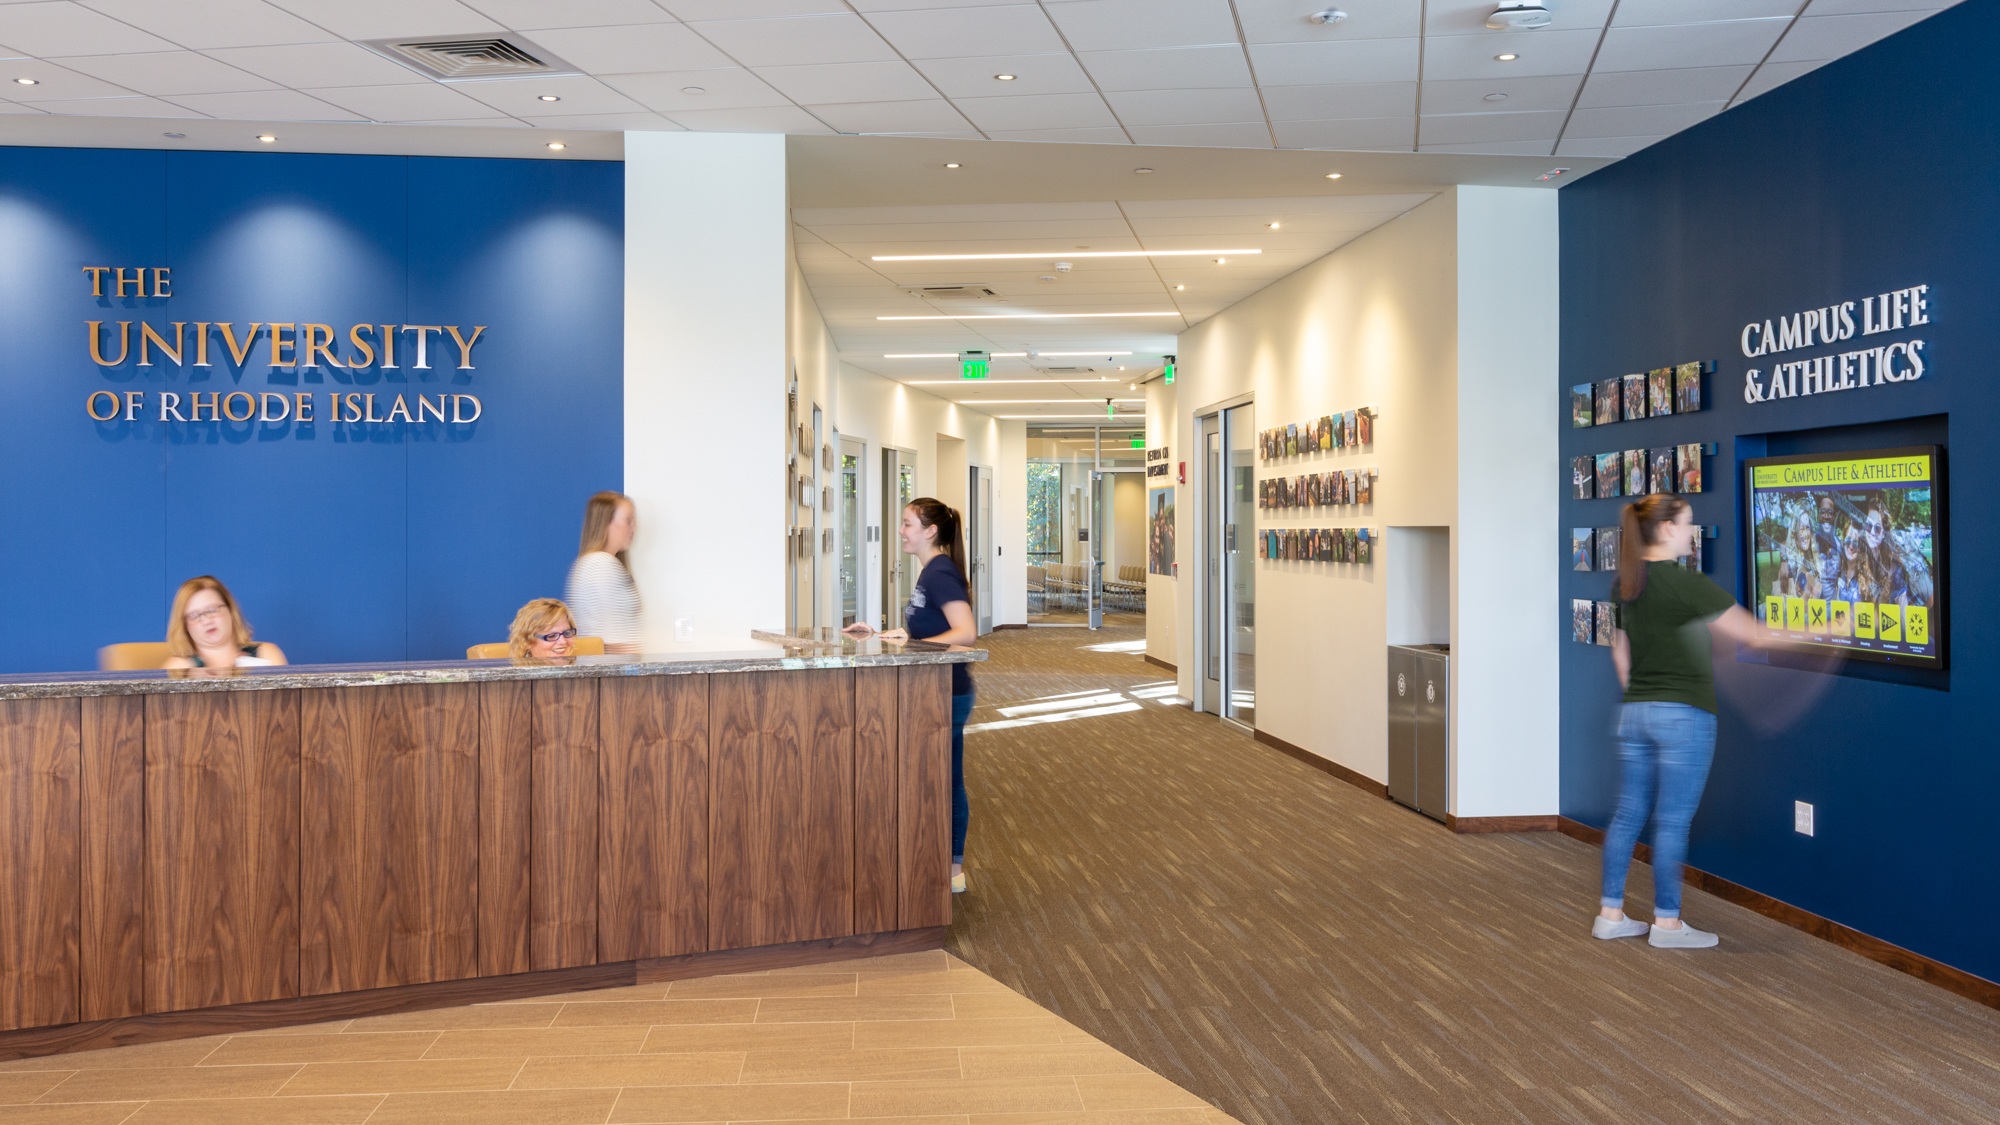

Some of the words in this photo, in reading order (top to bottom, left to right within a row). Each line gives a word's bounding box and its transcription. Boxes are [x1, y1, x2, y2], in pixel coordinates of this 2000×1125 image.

[83, 267, 172, 297] THE
[1741, 302, 1856, 358] CAMPUS
[1862, 284, 1929, 336] LIFE
[84, 321, 488, 370] UNIVERSITY
[964, 361, 987, 378] EXIT
[1744, 369, 1766, 404] &
[1767, 340, 1925, 400] ATHLETICS
[87, 391, 144, 421] OF
[158, 391, 313, 422] RHODE
[329, 393, 482, 423] ISLAND
[1851, 464, 1859, 480] &
